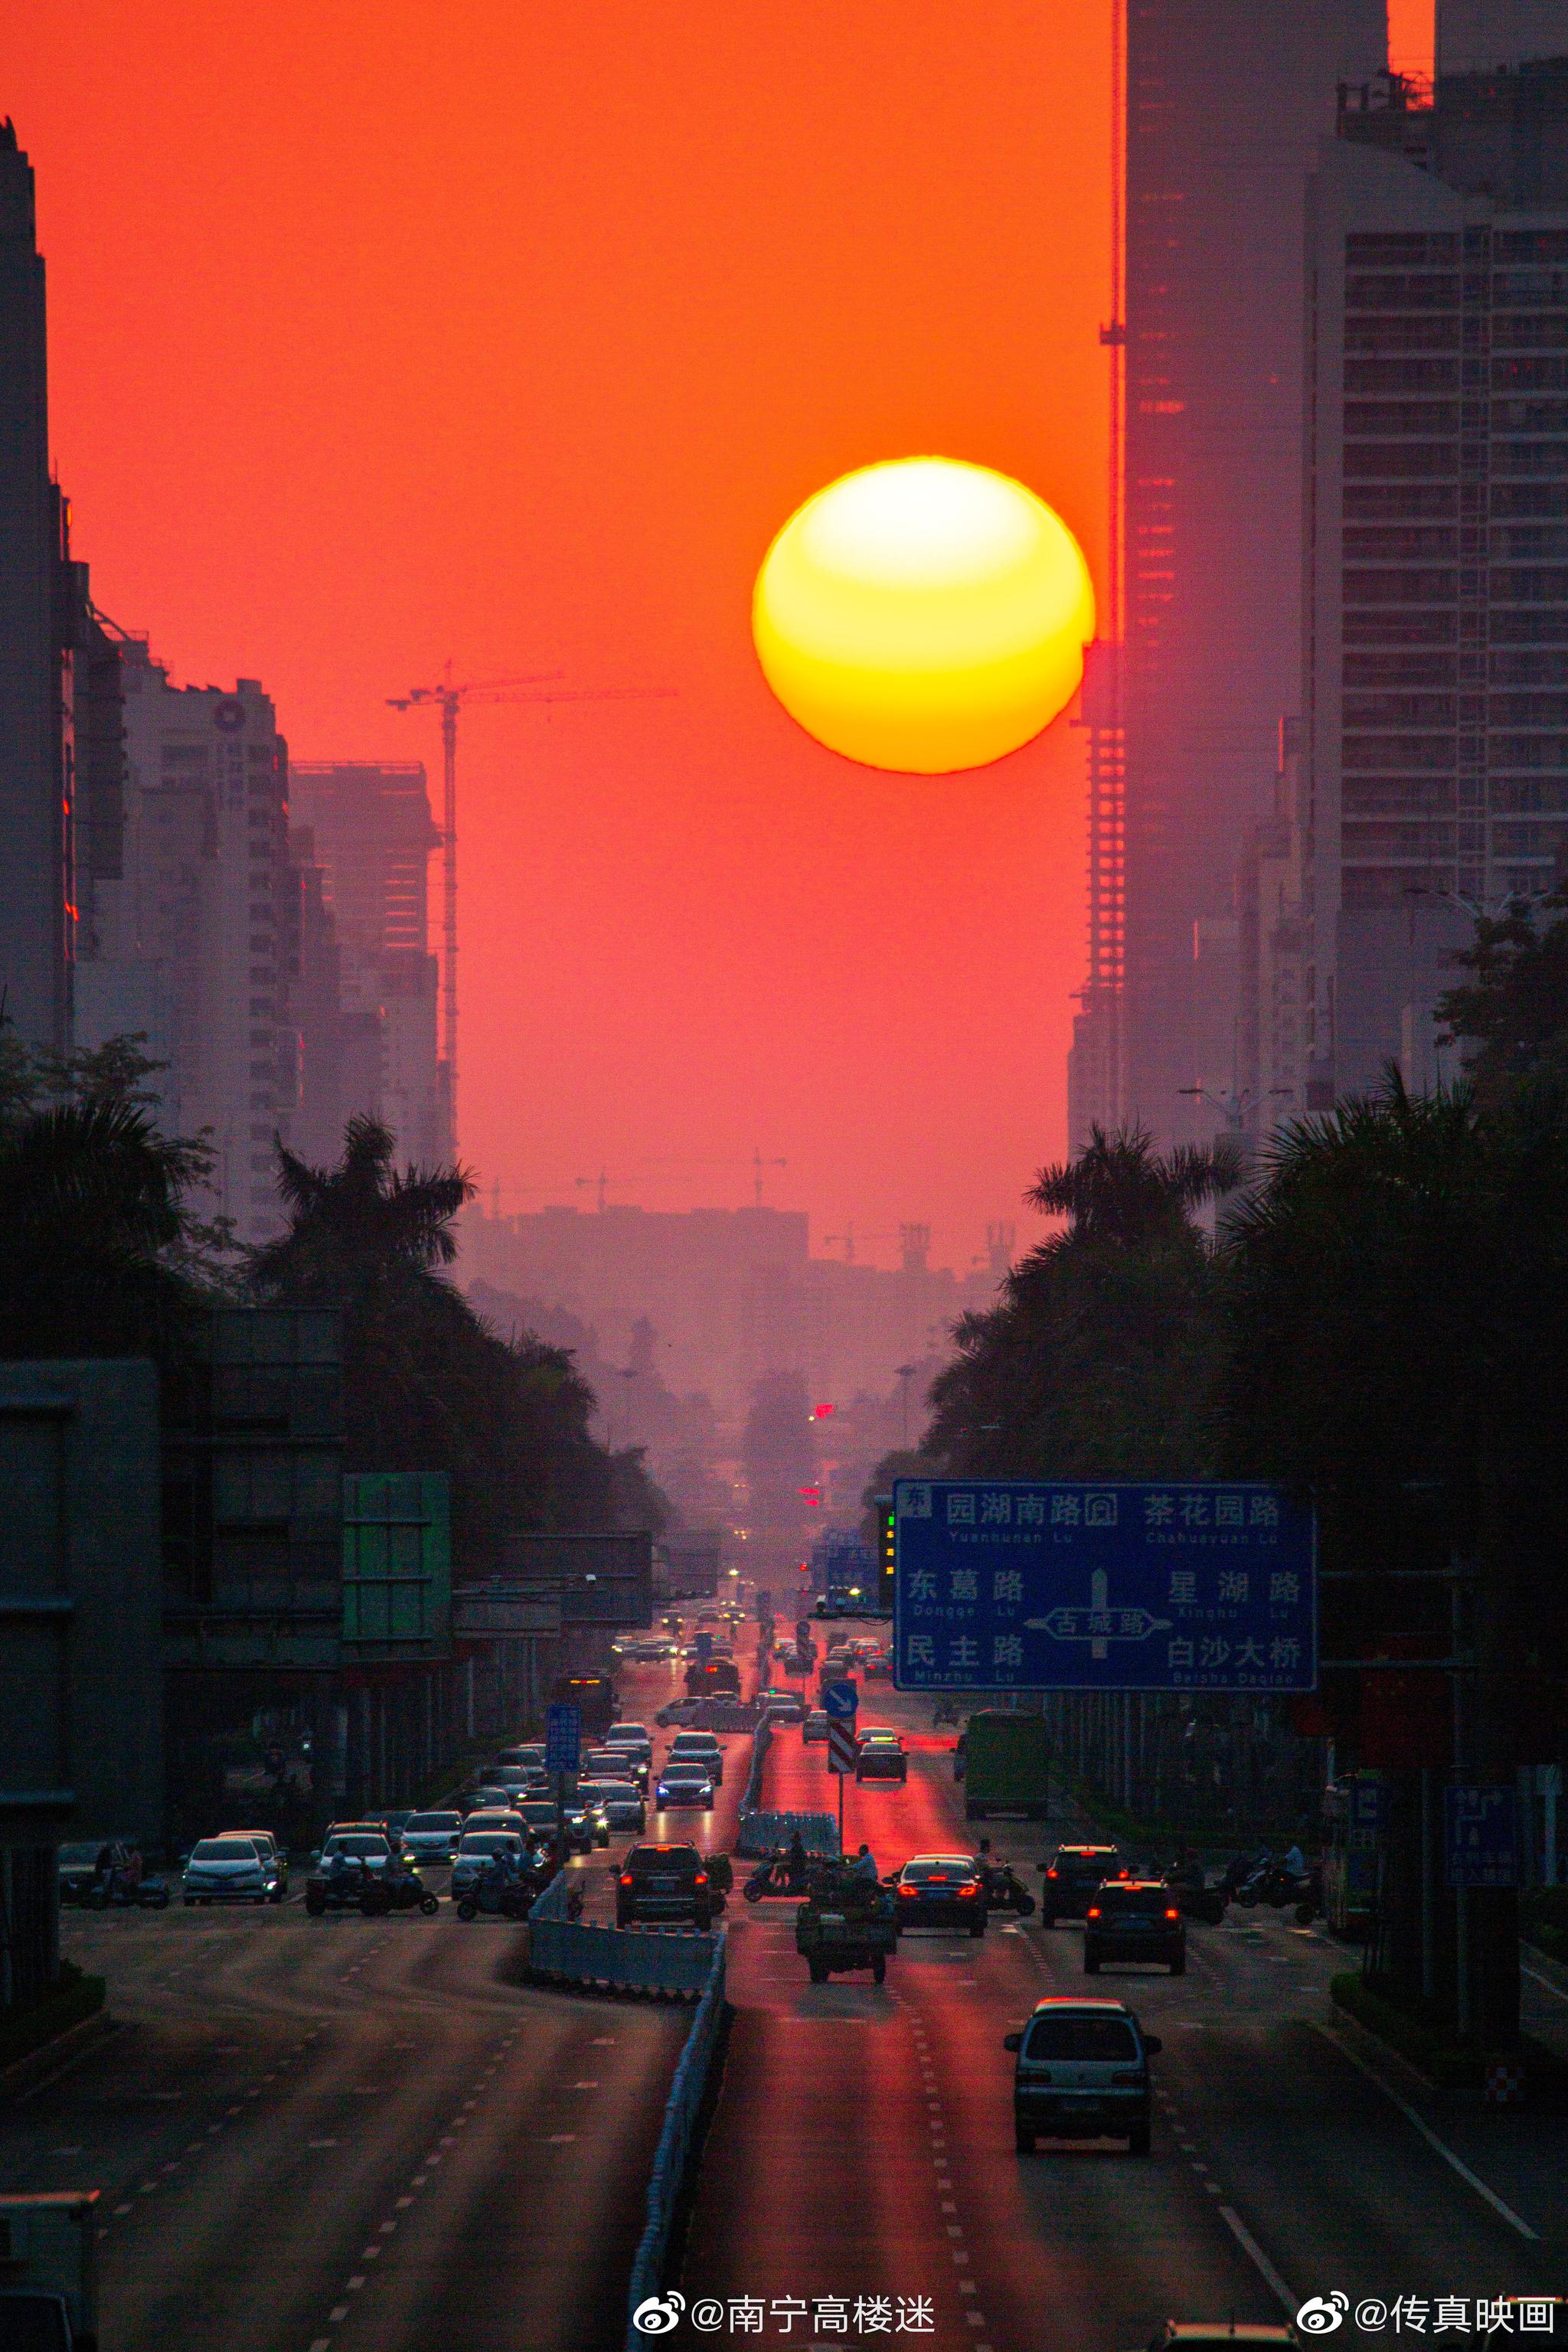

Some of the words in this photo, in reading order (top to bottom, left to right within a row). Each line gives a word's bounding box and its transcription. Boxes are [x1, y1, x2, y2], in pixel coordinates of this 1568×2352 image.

[947, 1492, 1081, 1526] 园湖南路
[1144, 1493, 1279, 1527] 茶花园路
[1054, 1531, 1073, 1544] Lu
[1259, 1532, 1278, 1544] Lu
[906, 1568, 1024, 1602] 东葛路
[1168, 1570, 1301, 1603] 星湖路
[996, 1605, 1016, 1617] Lu
[1054, 1612, 1145, 1635] 古城路
[1269, 1607, 1289, 1619] Lu
[906, 1634, 1024, 1668] 民主路
[1167, 1635, 1302, 1669] 白沙大桥
[995, 1670, 1014, 1682] Lu
